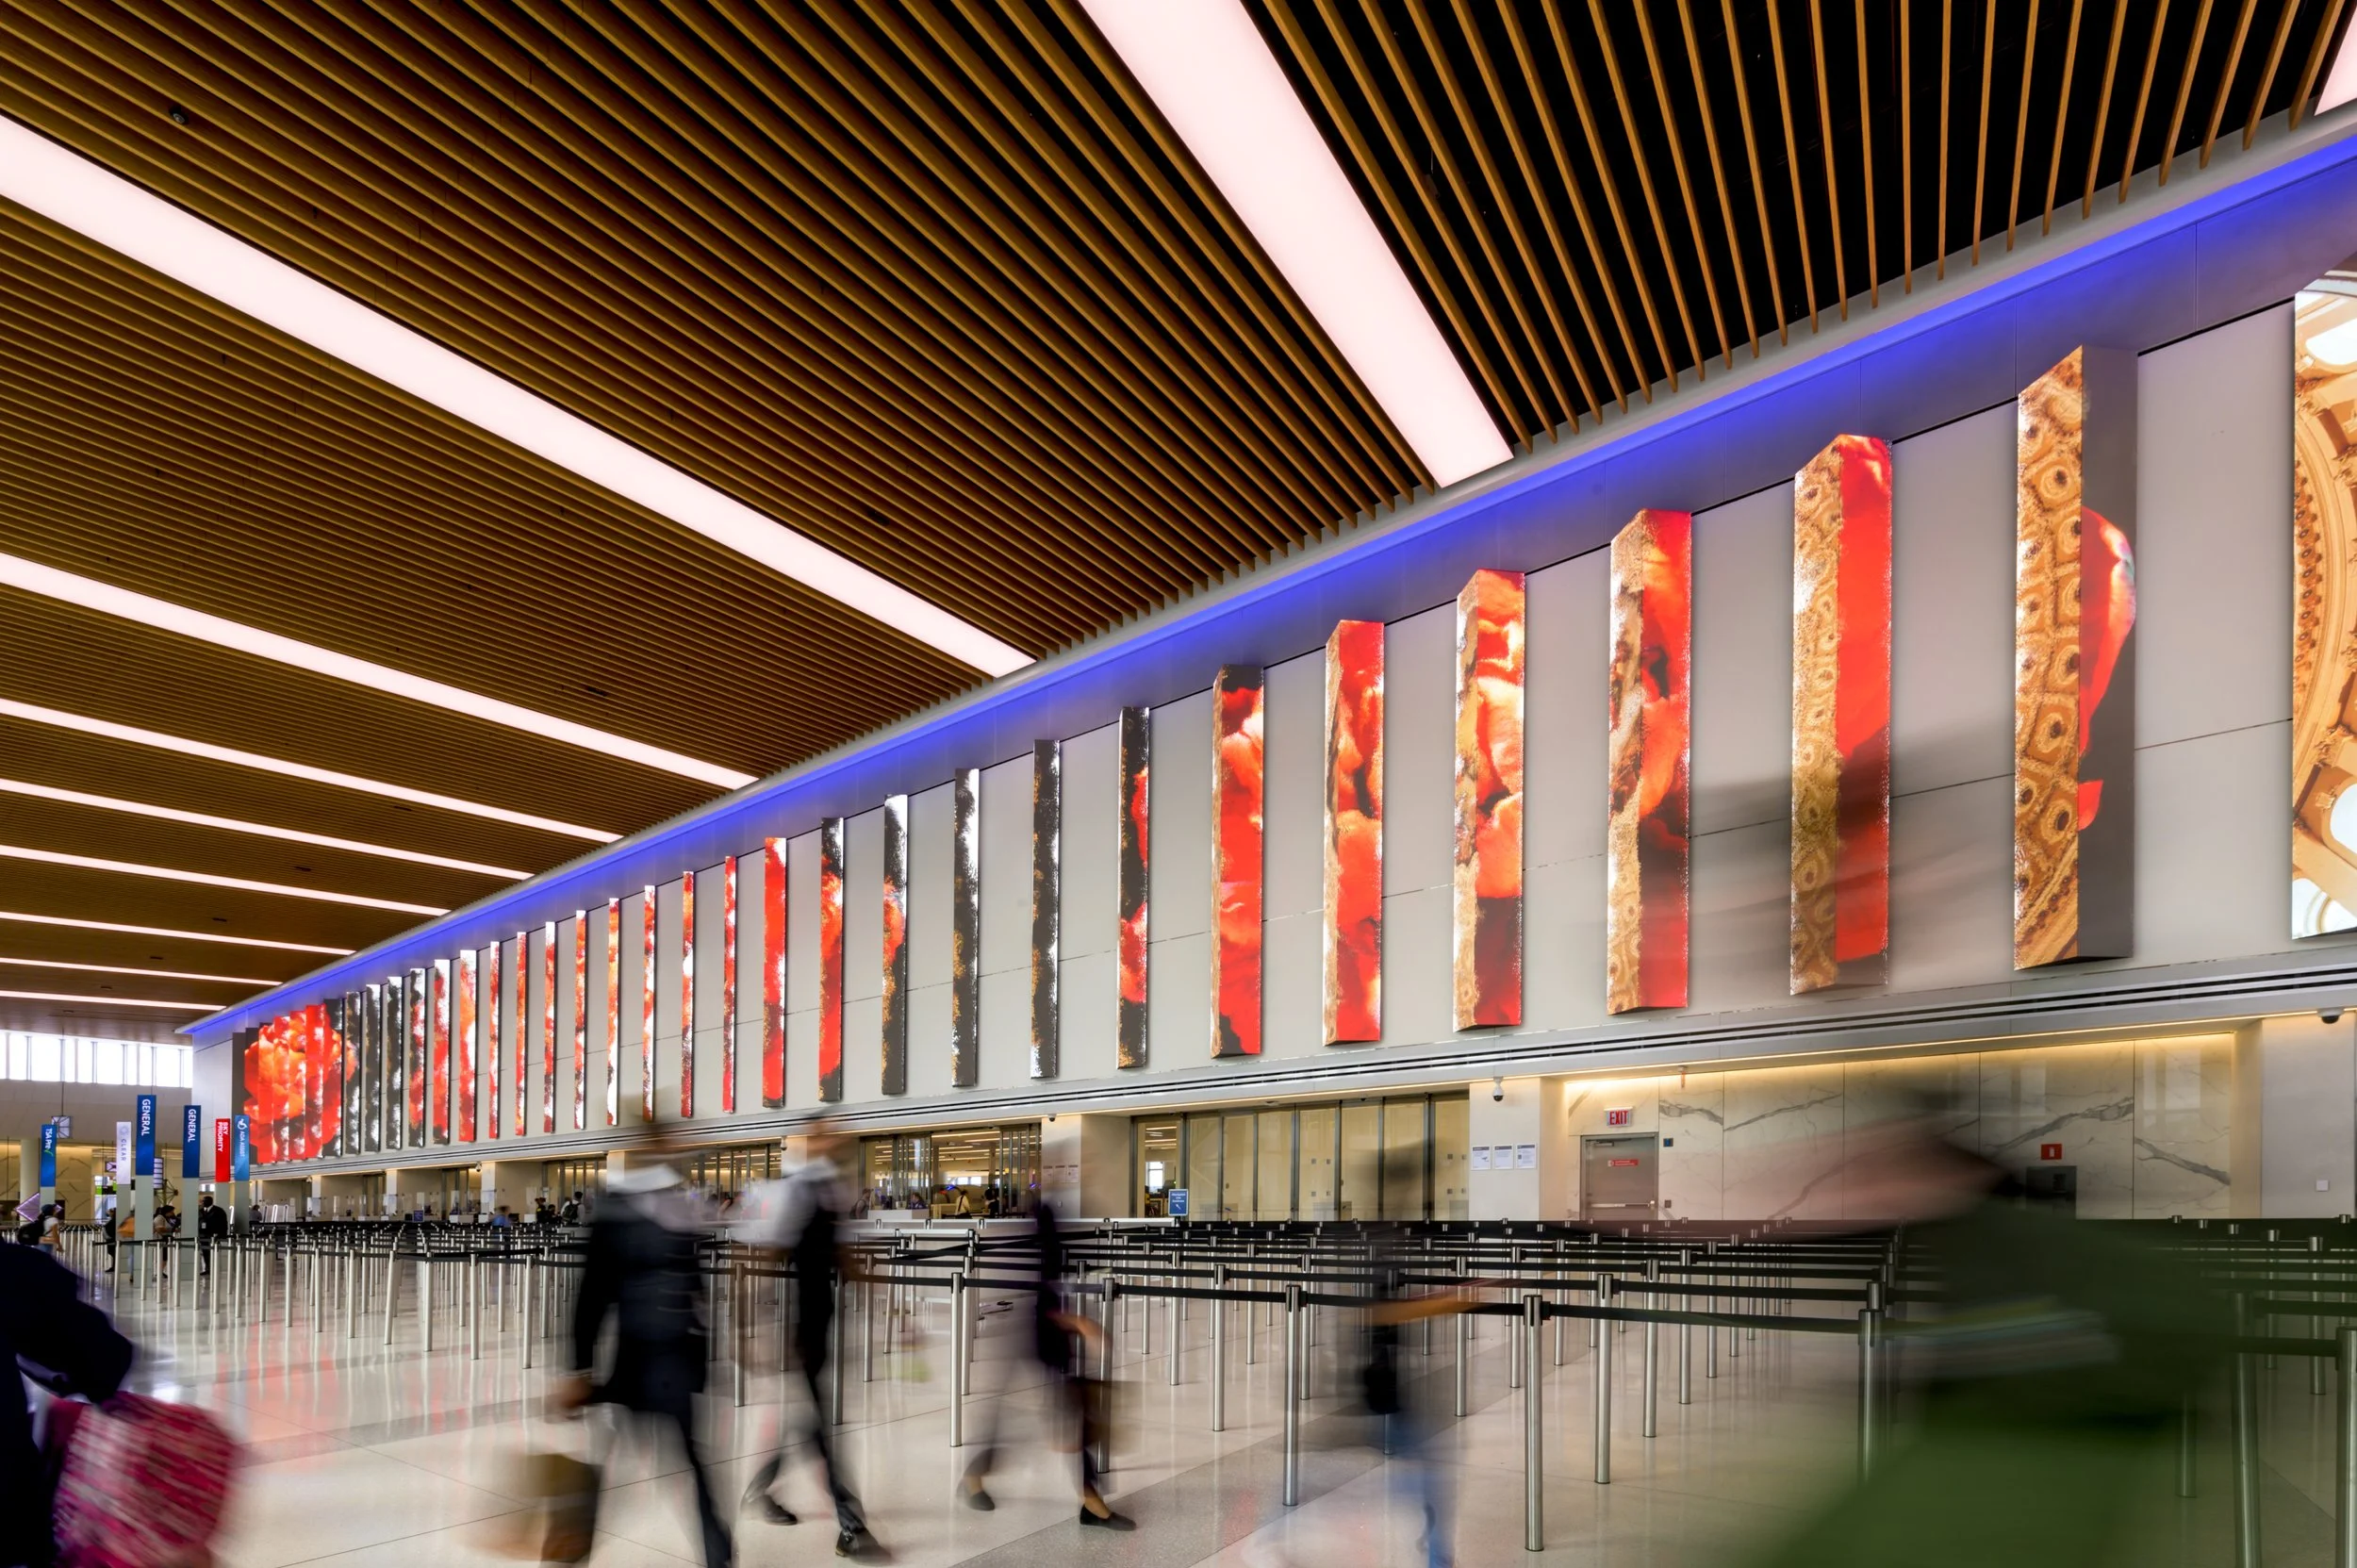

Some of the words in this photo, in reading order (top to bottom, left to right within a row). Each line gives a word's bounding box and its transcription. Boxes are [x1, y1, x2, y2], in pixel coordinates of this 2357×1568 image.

[141, 1098, 150, 1135] GENERAL
[188, 1109, 196, 1142] GENERAL
[1609, 1111, 1628, 1125] EXIT
